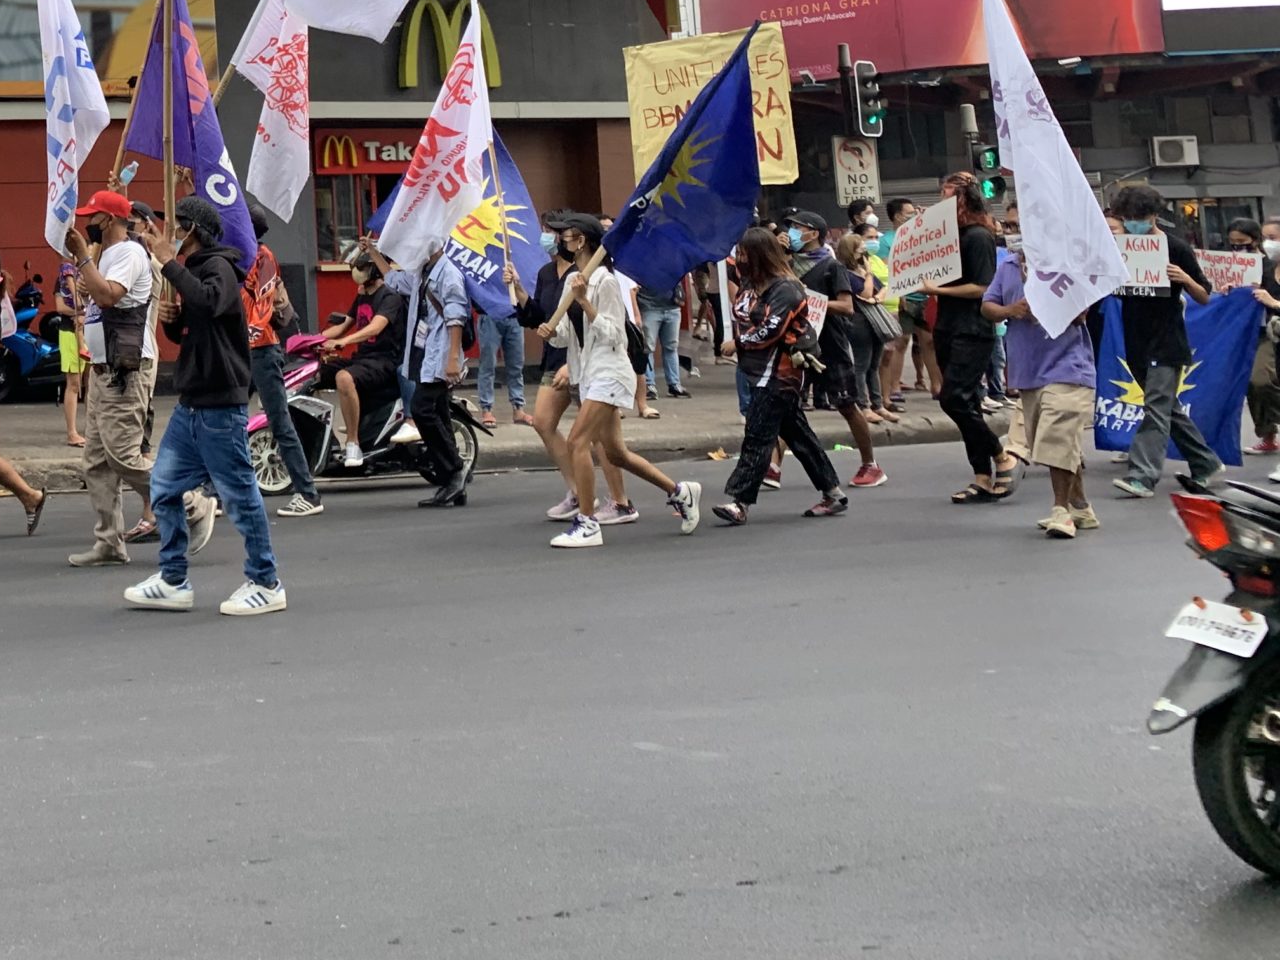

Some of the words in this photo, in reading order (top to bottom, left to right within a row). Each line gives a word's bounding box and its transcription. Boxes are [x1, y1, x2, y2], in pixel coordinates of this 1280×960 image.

[760, 1, 831, 21] CATRIONA
[781, 18, 803, 27] Beauty
[364, 141, 413, 161] Tak
[848, 173, 869, 185] NO
[1125, 239, 1160, 252] AGAIN
[891, 239, 960, 277] Revisionism!
[1135, 268, 1161, 284] LAW
